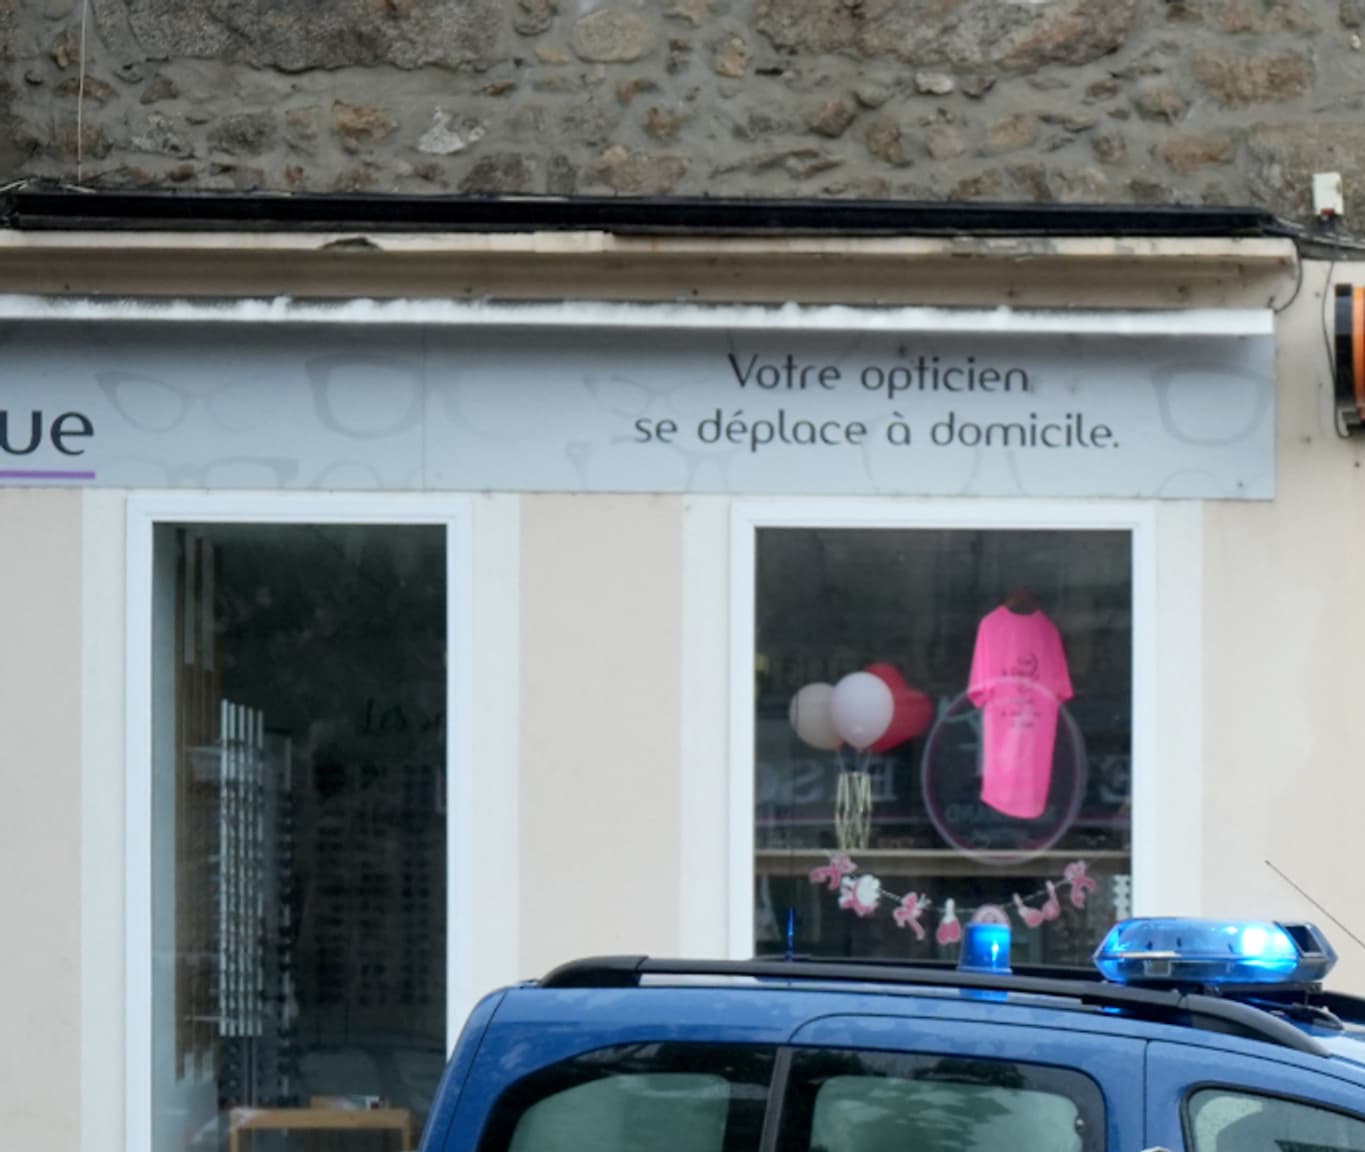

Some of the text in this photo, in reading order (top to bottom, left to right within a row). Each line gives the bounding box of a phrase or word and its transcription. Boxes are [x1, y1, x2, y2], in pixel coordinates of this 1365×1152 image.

[728, 352, 1029, 399] Votre opticien
[634, 407, 1119, 453] se déplace à domicile.
